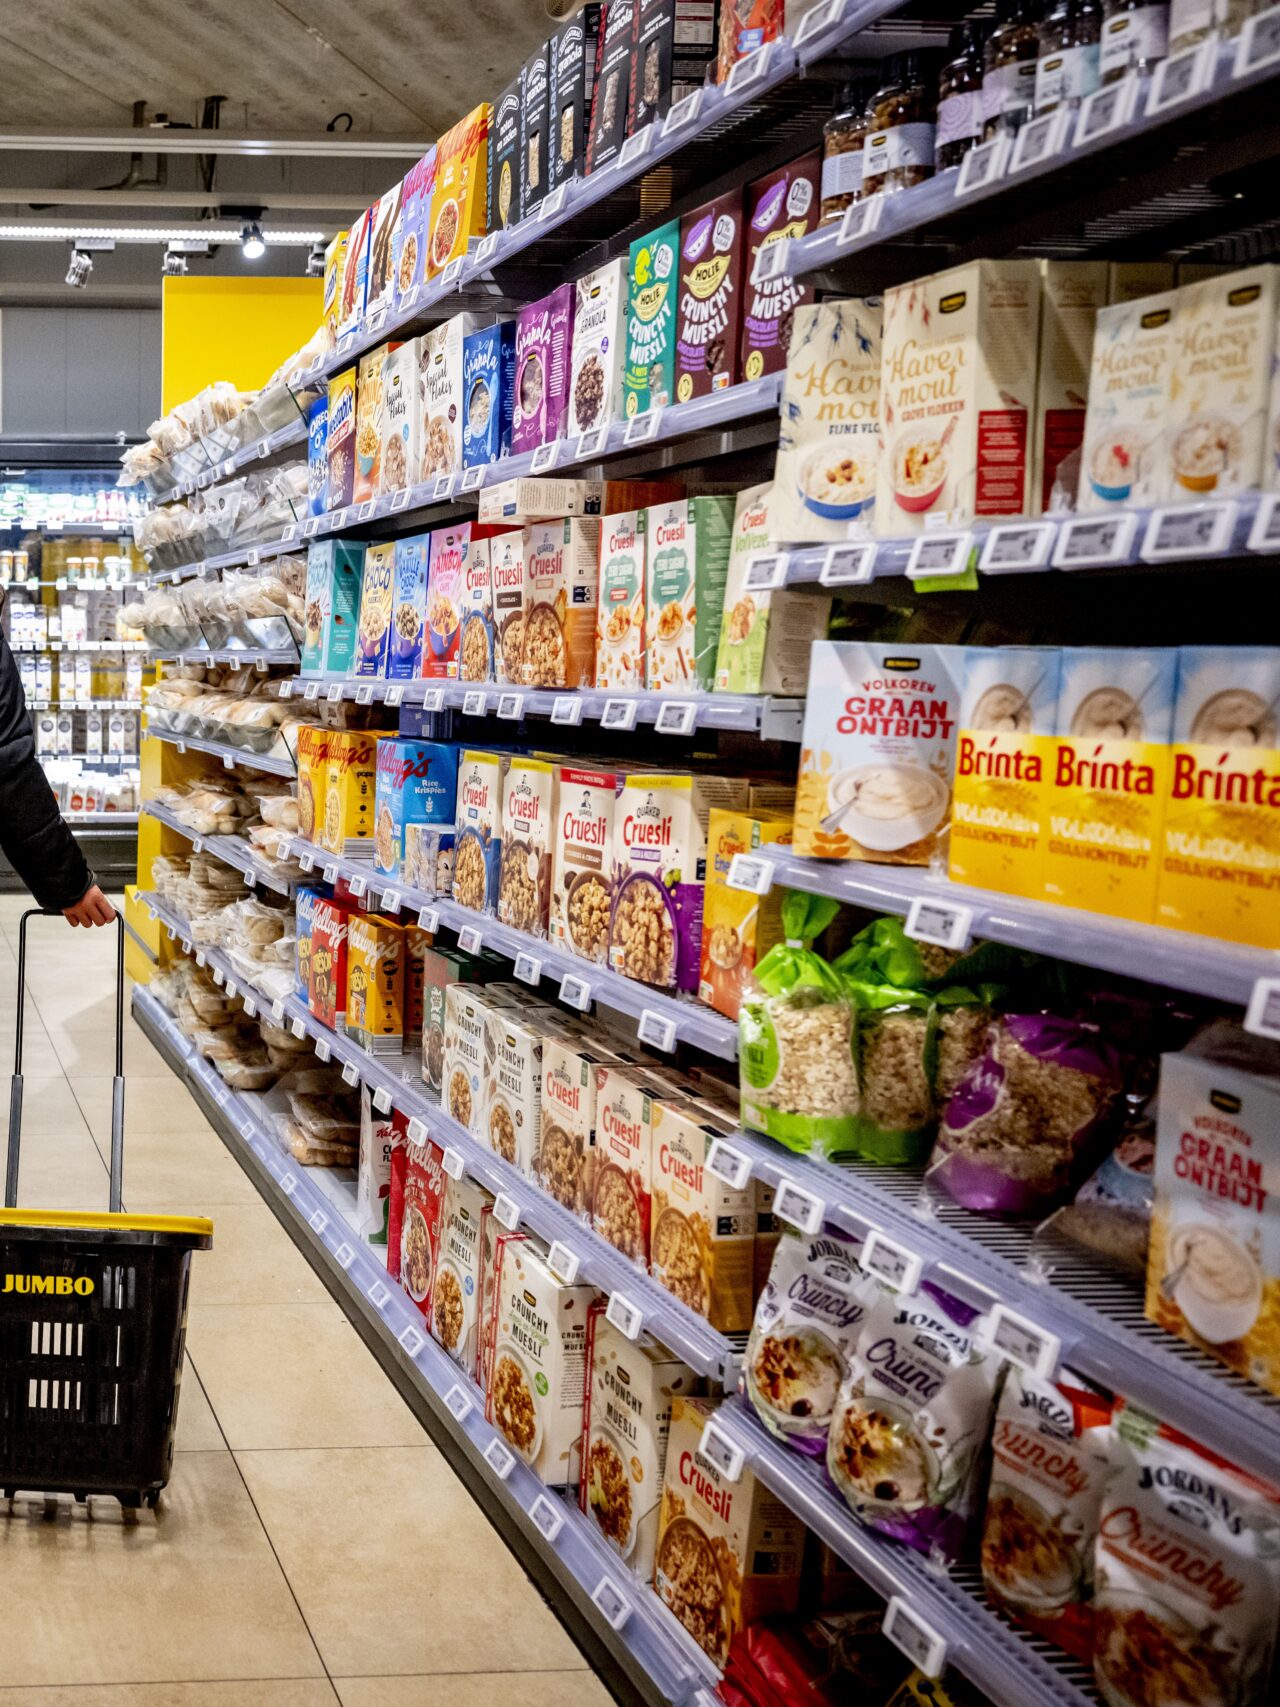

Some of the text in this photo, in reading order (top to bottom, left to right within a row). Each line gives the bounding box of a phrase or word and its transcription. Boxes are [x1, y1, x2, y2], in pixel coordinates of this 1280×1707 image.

[605, 9, 633, 43] granola
[558, 45, 583, 77] granola
[526, 78, 547, 106] granola
[500, 116, 514, 136] noten
[502, 127, 517, 149] zaden
[695, 262, 721, 282] HOLIE
[640, 288, 661, 305] HOLIE
[680, 274, 734, 324] CRUNCHY
[752, 284, 806, 319] MUESLI
[516, 311, 551, 356] Granola
[580, 309, 608, 333] GRANOLA
[629, 299, 671, 342] CRUNCHY
[682, 309, 728, 345] MUESLI
[631, 332, 667, 364] MUESLI
[886, 338, 966, 384] Haver
[463, 349, 498, 381] Granola
[794, 358, 881, 397] Hav
[431, 380, 454, 401] Flakes
[898, 365, 961, 408] mout
[389, 402, 408, 420] Flakes
[829, 424, 859, 436] FIJNE
[610, 531, 635, 553] Cruesli
[656, 522, 686, 546] Cruesli
[365, 566, 391, 592] CHOCO
[494, 562, 523, 589] Cruesli
[528, 550, 563, 580] Cruesli
[862, 678, 937, 694] VOLKOREN
[844, 697, 949, 721] GRAAN
[836, 717, 955, 740] ONTBIJT
[357, 771, 374, 779] pops
[377, 742, 433, 791] Kellogg's
[958, 736, 1042, 783] Brinta
[1055, 744, 1156, 795] Brinta
[415, 786, 446, 795] Krispies
[422, 779, 439, 788] Rice
[463, 780, 488, 809] Cruesli
[515, 784, 532, 796] QUAKER
[1171, 753, 1280, 808] Brinta
[509, 795, 540, 821] Cruesli
[636, 805, 661, 818] QUAKER
[563, 812, 607, 846] Cruesli
[623, 815, 672, 846] Cruesli
[458, 1014, 482, 1038] CRUNCHY
[459, 1039, 478, 1060] MUESLI
[497, 1043, 525, 1070] CRUNCHY
[499, 1069, 522, 1094] MUESLI
[547, 1072, 580, 1111] Cruesli
[602, 1105, 642, 1150] Cruesli
[660, 1144, 704, 1193] Cruesli
[1179, 1131, 1262, 1185] GRAAN
[1174, 1157, 1268, 1213] ONTBIJT
[450, 1213, 477, 1244] CRUNCHY
[450, 1237, 471, 1261] MUESLI
[2, 1274, 95, 1295] JUMBO
[511, 1294, 549, 1336] CRUNCHY
[512, 1323, 542, 1358] MUESLI
[604, 1370, 643, 1416] CRUNCHY
[606, 1401, 637, 1441] MUESLI
[679, 1451, 733, 1522] Cruesli
[1139, 1466, 1242, 1536] JORDANS
[1100, 1506, 1245, 1612] Crunchy
